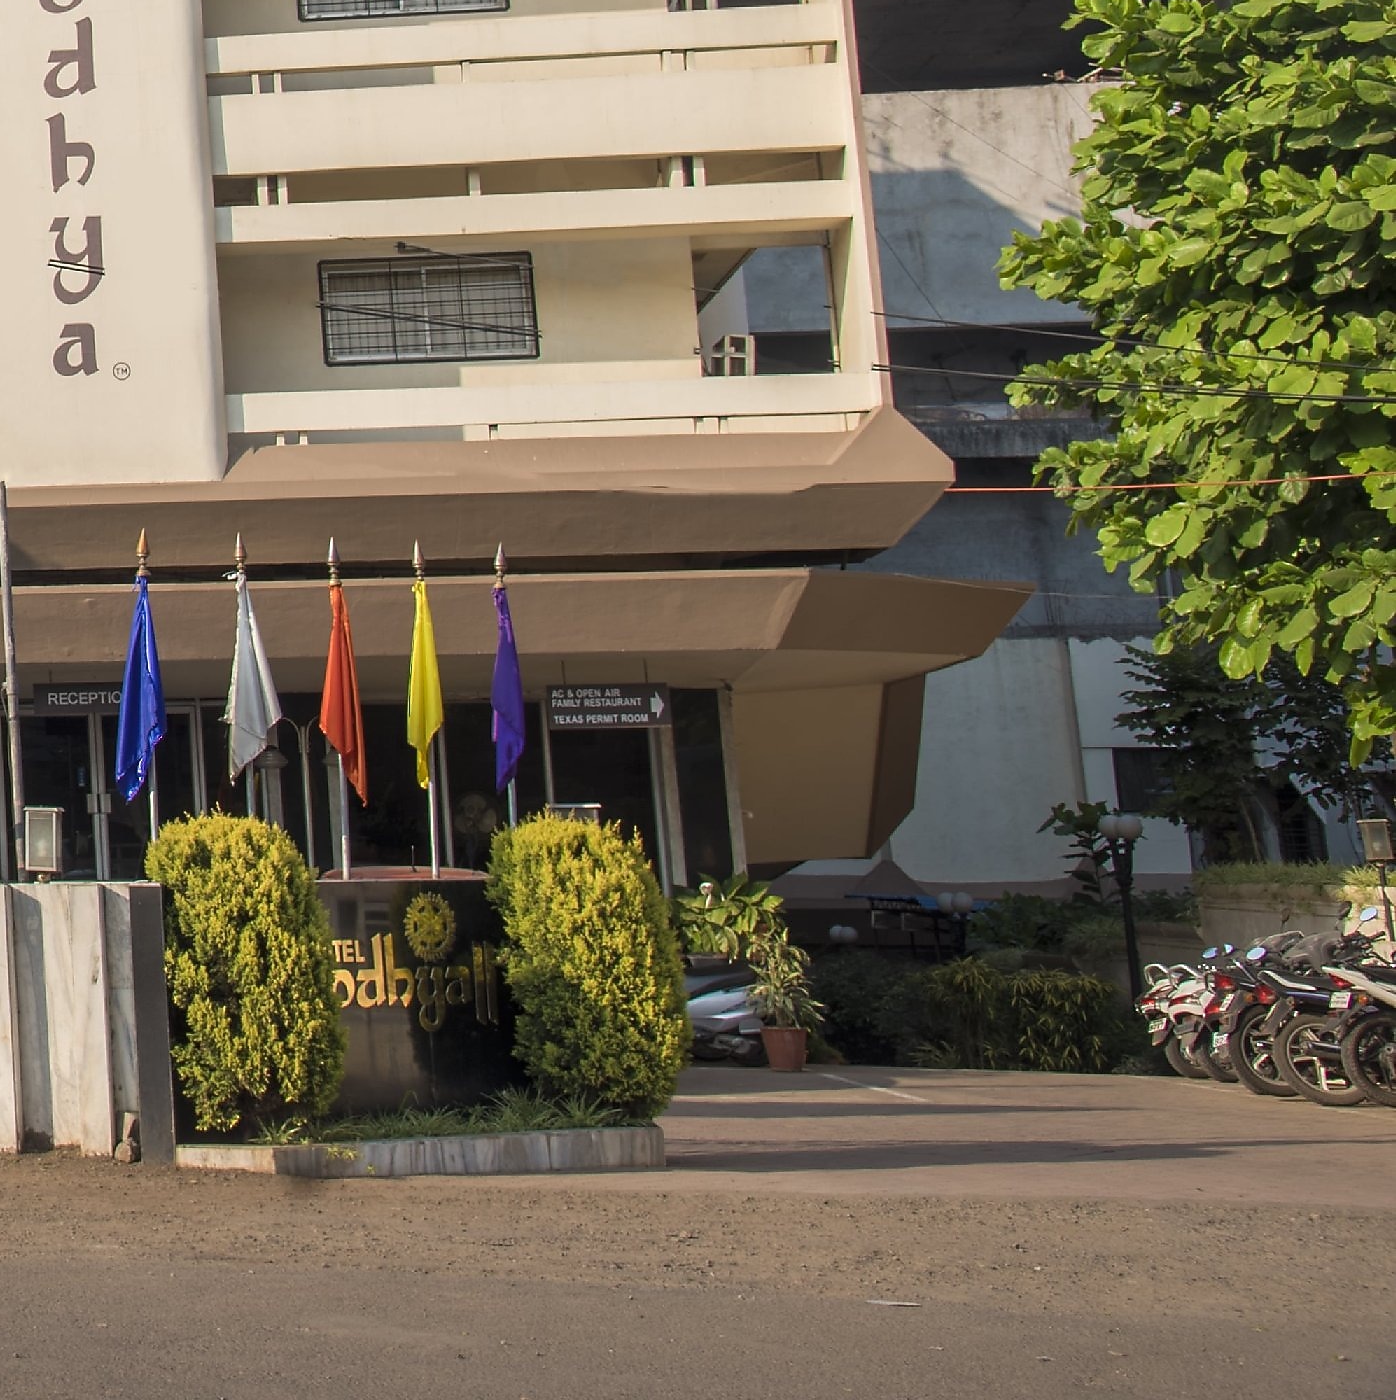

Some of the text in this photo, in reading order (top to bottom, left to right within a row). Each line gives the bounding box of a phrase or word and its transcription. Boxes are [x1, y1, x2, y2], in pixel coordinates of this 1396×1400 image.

[47, 690, 122, 706] RECEPTIO
[551, 690, 564, 699] AC
[575, 688, 601, 698] OPEN
[604, 688, 620, 697] AIR
[551, 697, 642, 708] FAMILY RESTAURANT
[553, 713, 649, 725] TEXAS PERMIT ROOM
[332, 939, 366, 964] TEL
[332, 932, 472, 1033] odhya
